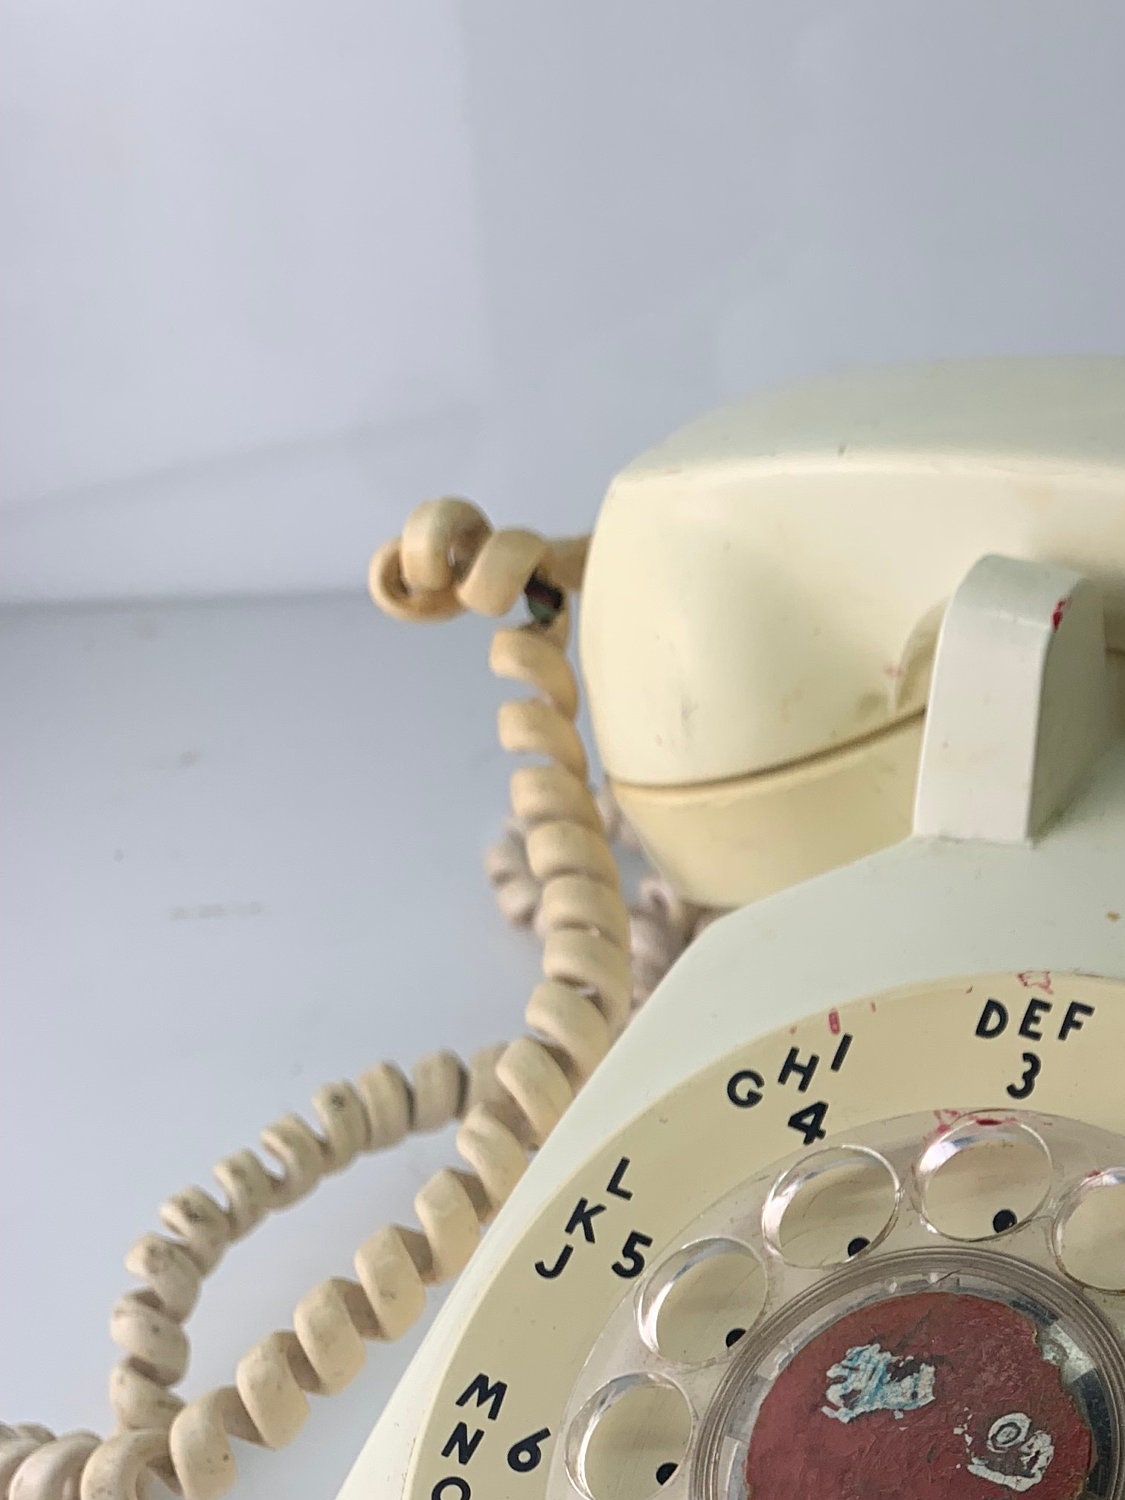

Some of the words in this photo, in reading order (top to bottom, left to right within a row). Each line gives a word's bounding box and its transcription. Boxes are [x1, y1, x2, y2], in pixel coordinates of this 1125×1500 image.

[975, 997, 1095, 1041] DEF
[726, 1032, 854, 1109] GHI
[1006, 1052, 1042, 1100] 3
[787, 1101, 829, 1146] 4
[534, 1156, 633, 1279] JKL
[611, 1230, 654, 1279] 5
[506, 1427, 552, 1473] 6
